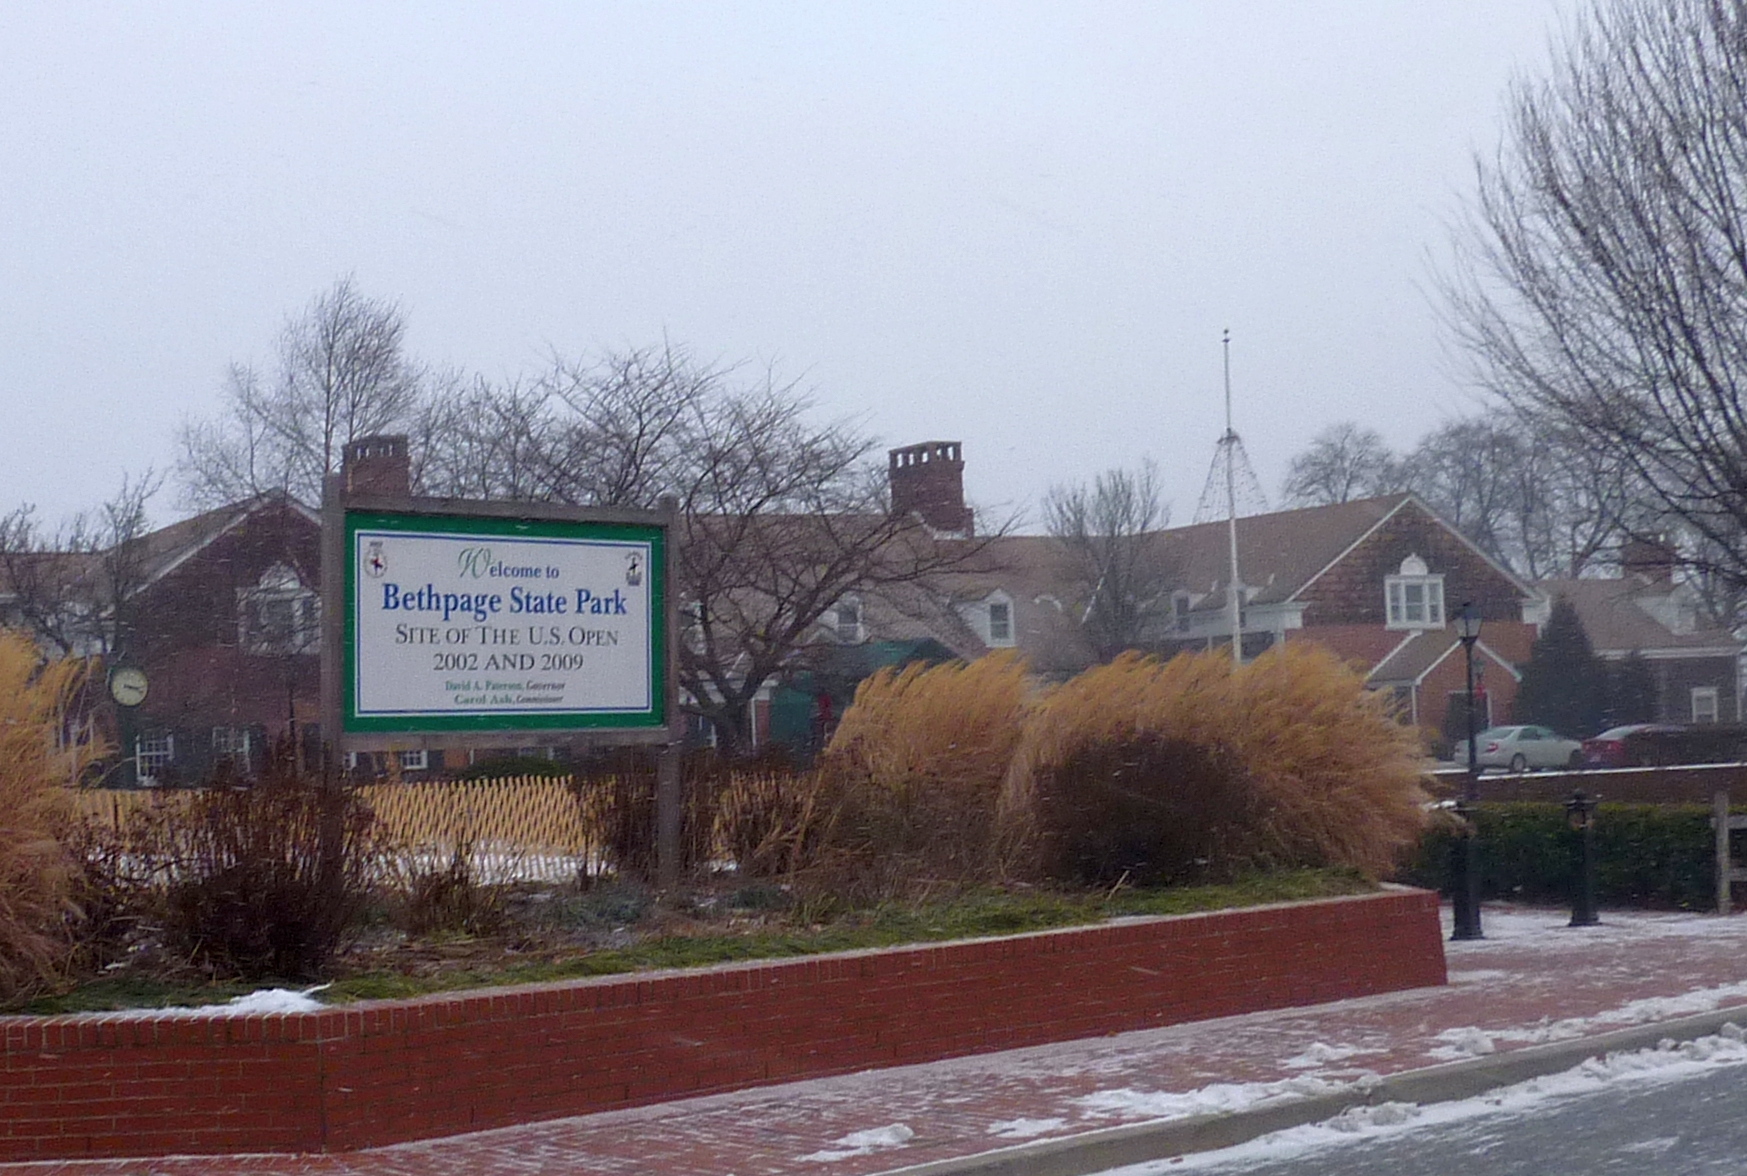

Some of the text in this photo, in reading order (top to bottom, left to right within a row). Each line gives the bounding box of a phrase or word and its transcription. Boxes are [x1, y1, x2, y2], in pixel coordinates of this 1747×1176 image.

[458, 547, 560, 579] Welcome to
[382, 582, 627, 622] Bethpage State Park
[395, 623, 440, 644] SITE
[446, 627, 472, 644] OF
[474, 625, 521, 645] THE
[569, 625, 619, 646] OPEN
[433, 653, 584, 671] 2002 AND 2009
